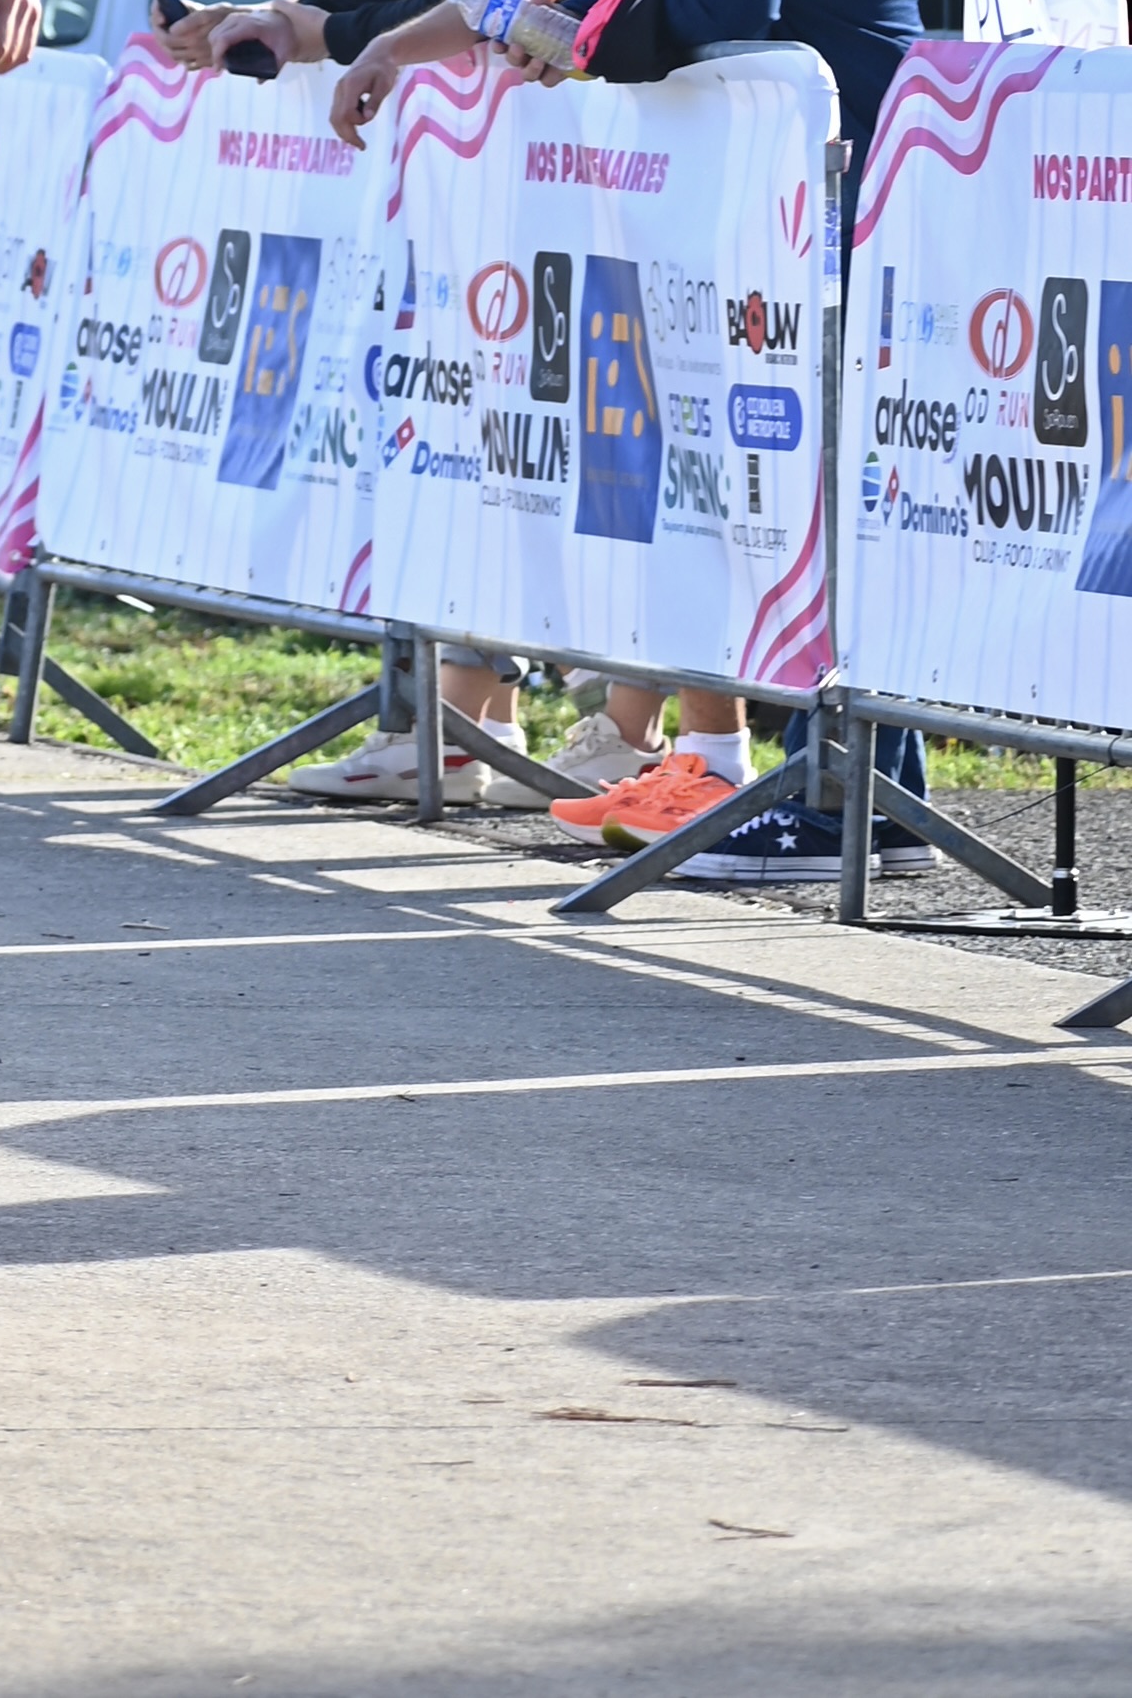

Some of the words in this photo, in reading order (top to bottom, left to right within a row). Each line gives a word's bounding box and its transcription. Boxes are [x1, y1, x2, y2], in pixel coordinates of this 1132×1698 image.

[525, 141, 557, 183] NOS
[1033, 154, 1072, 200] NOS
[383, 339, 473, 407] arkose
[875, 377, 957, 452] arkose
[410, 440, 482, 482] Domino's
[481, 408, 566, 482] MOULIN
[900, 491, 968, 538] Domino's
[964, 453, 1081, 536] MOULIN
